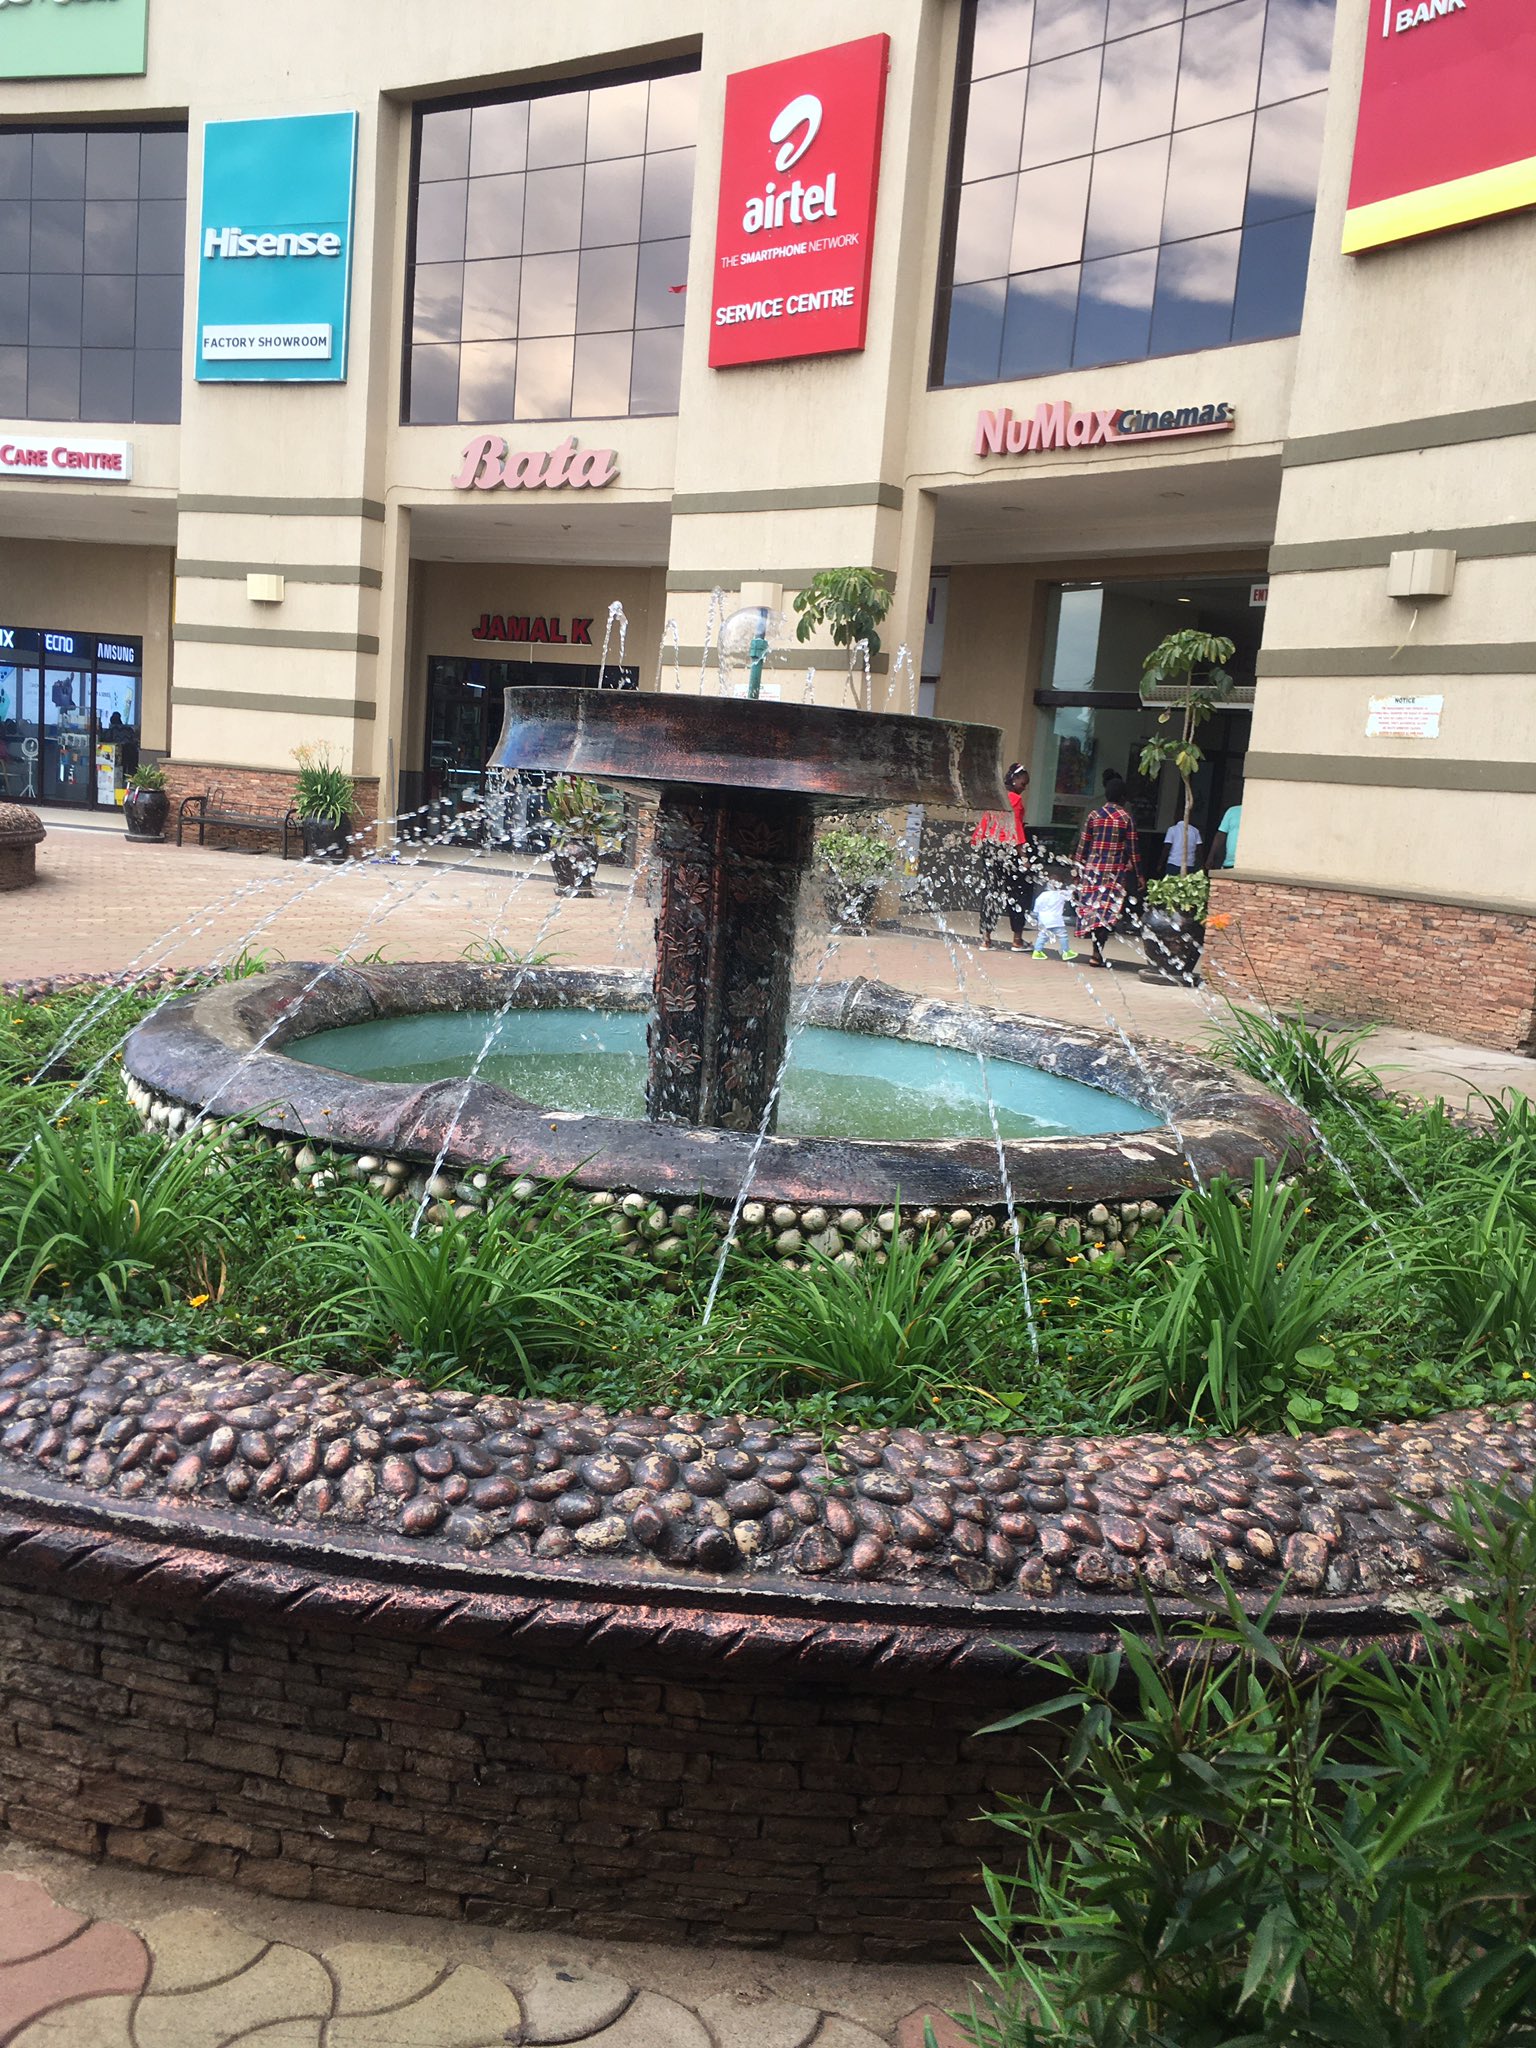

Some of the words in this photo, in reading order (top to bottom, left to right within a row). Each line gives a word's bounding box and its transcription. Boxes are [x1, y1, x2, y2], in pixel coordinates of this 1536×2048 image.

[742, 172, 837, 234] airtel
[204, 227, 342, 258] Hisense
[721, 254, 739, 268] THE
[740, 242, 808, 265] SMARTPHONE
[808, 233, 860, 253] NETWORK
[715, 297, 784, 327] SERVICE
[786, 286, 856, 316] CENTRE
[203, 337, 255, 348] FACTORY
[258, 336, 327, 348] SHOWROOM
[974, 400, 1118, 456] NuMax
[1118, 401, 1235, 434] Cinemas
[0, 444, 48, 467] CARE
[51, 447, 122, 471] CENTRE
[450, 433, 620, 490] Bata
[44, 633, 74, 653] ECNO
[472, 614, 567, 643] JAMAL
[570, 617, 594, 645] K
[97, 642, 135, 663] AMSUNG
